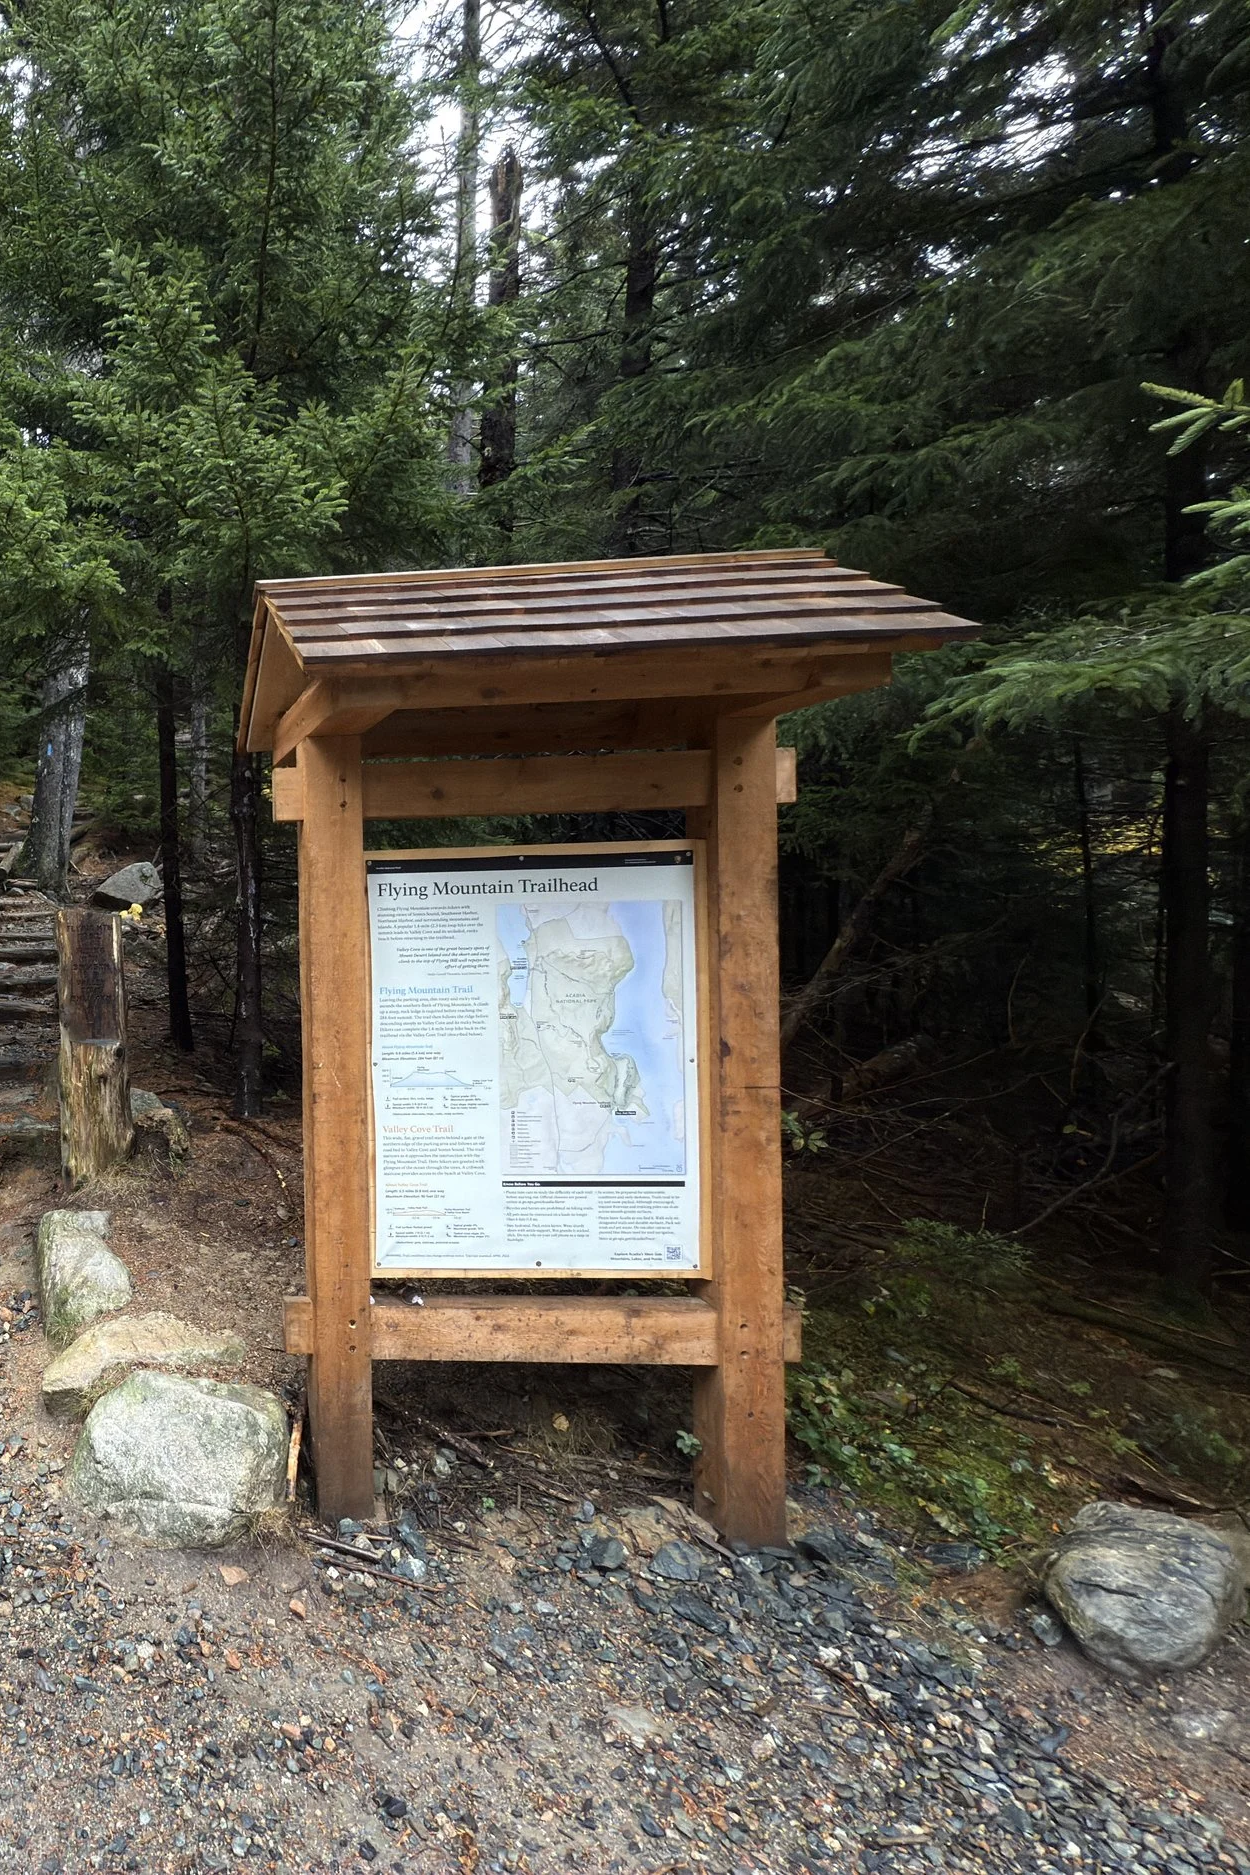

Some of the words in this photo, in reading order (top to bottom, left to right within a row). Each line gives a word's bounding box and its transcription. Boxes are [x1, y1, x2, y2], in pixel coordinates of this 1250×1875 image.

[377, 883, 428, 899] Flying
[433, 880, 514, 895] Mountain
[518, 878, 598, 894] Trailhead
[380, 987, 406, 996] Flying
[383, 1126, 409, 1135] Valley
